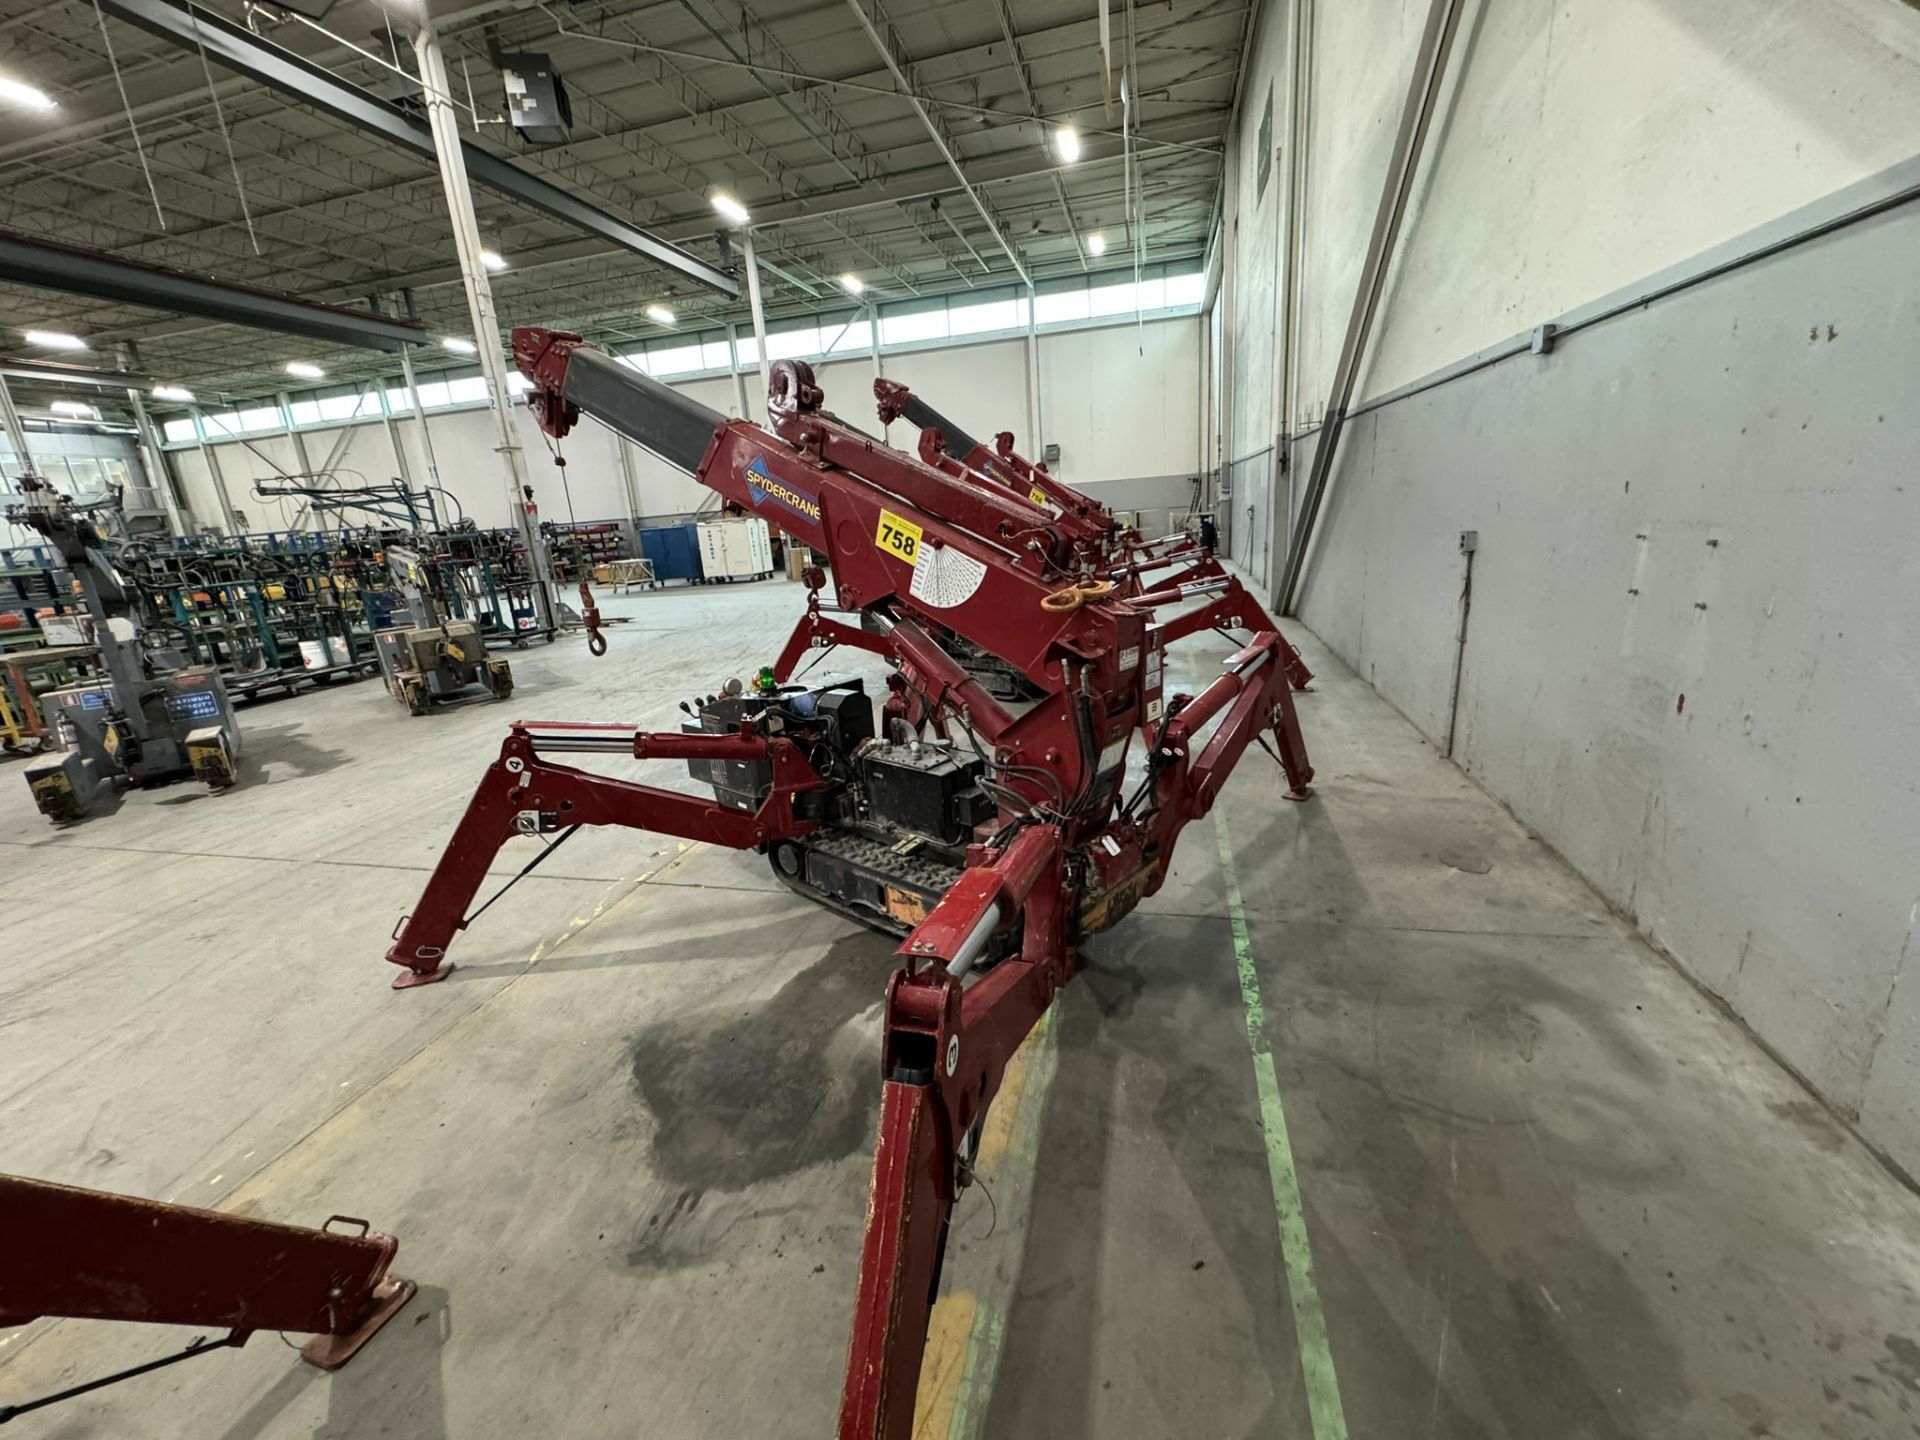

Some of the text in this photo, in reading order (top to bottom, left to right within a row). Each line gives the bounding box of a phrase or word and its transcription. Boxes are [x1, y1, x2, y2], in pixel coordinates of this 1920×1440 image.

[746, 469, 821, 521] SPYDERCRANE
[881, 523, 915, 557] 758
[169, 702, 213, 710] AACITY
[509, 760, 521, 770] 4
[948, 1042, 957, 1068] 3
